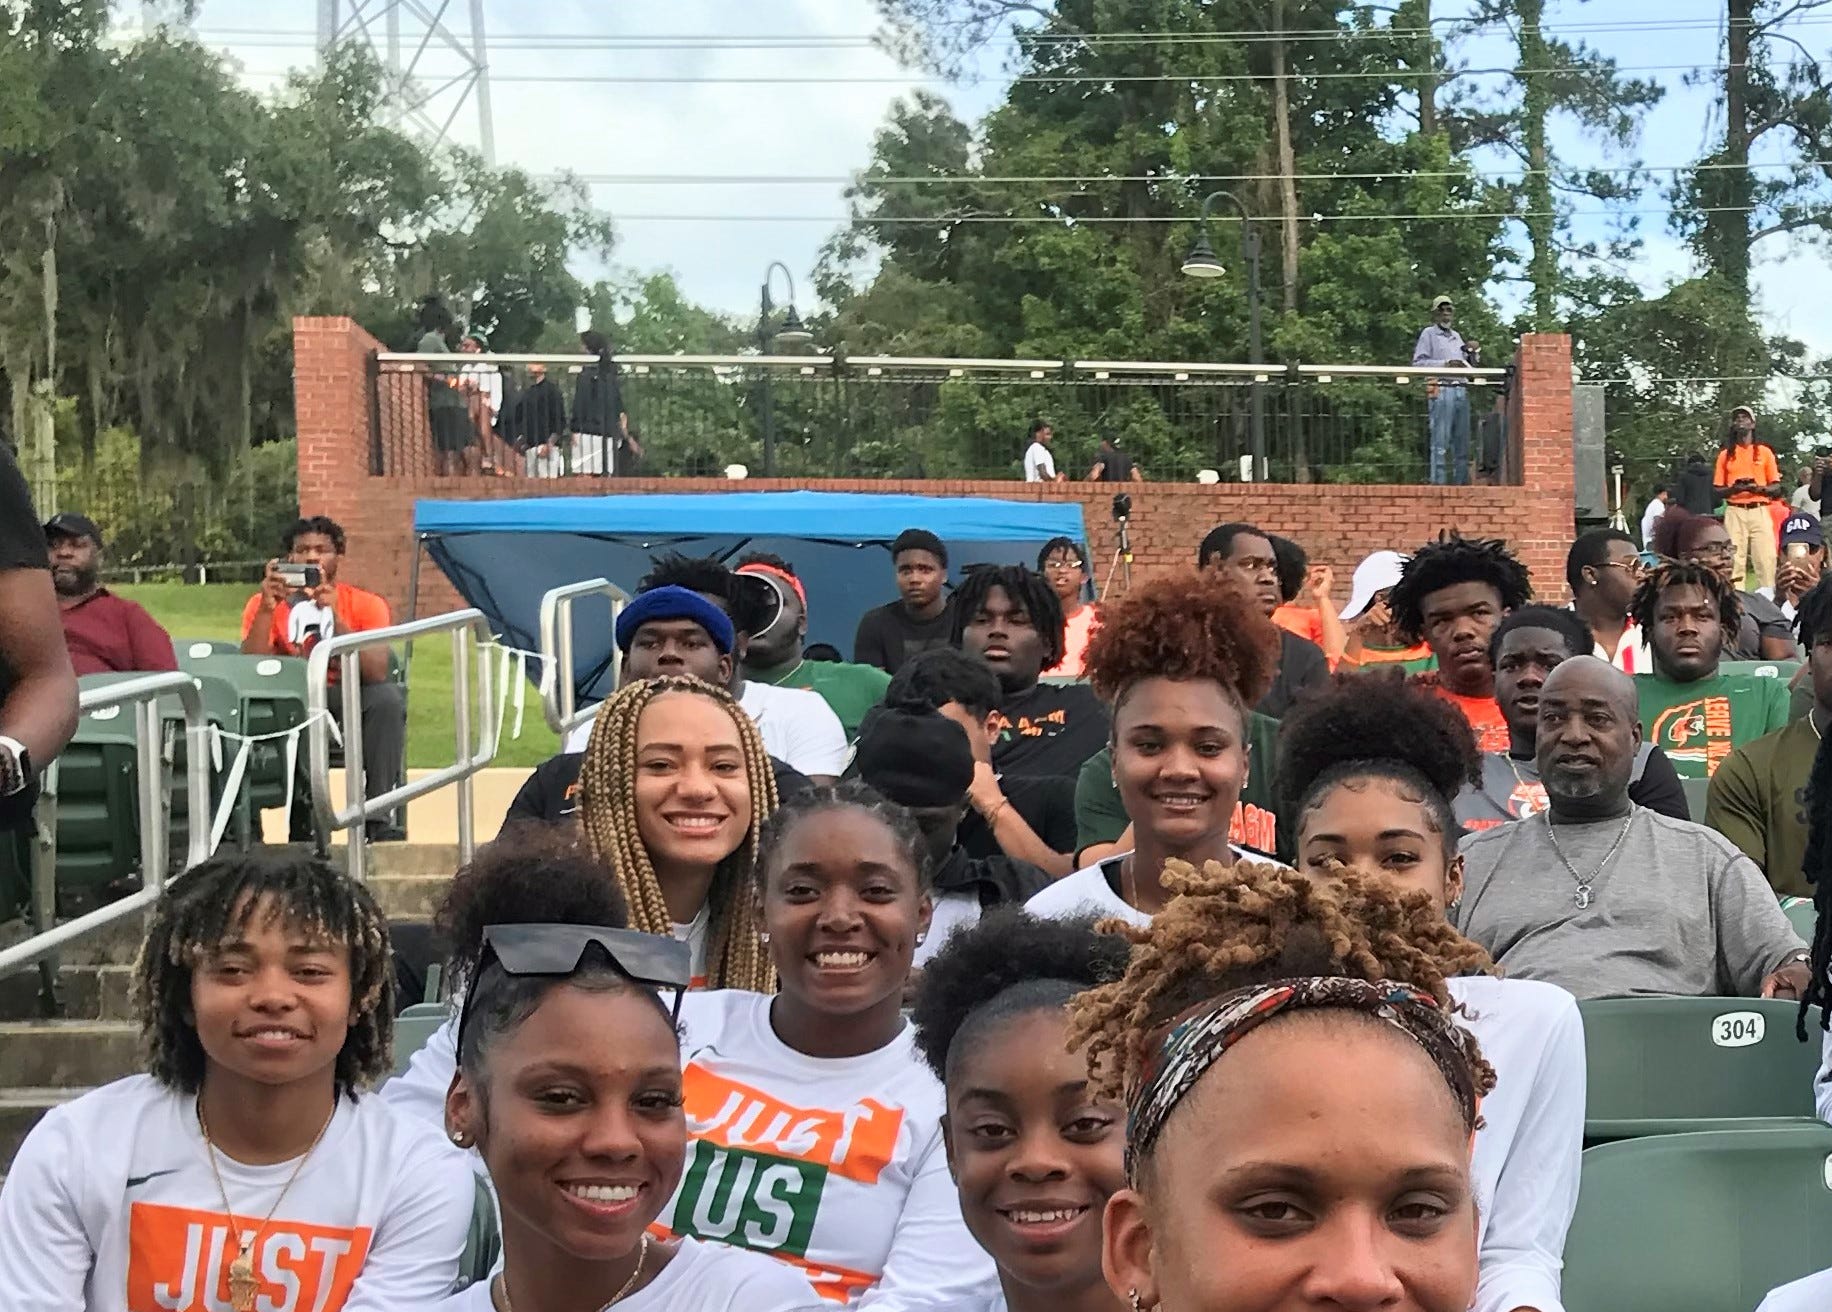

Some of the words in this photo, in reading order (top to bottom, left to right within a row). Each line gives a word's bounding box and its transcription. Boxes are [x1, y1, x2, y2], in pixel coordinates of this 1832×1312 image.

[1786, 518, 1811, 533] GAP
[1720, 1018, 1757, 1041] 304
[686, 1090, 874, 1165] JUST
[691, 1150, 805, 1250] US
